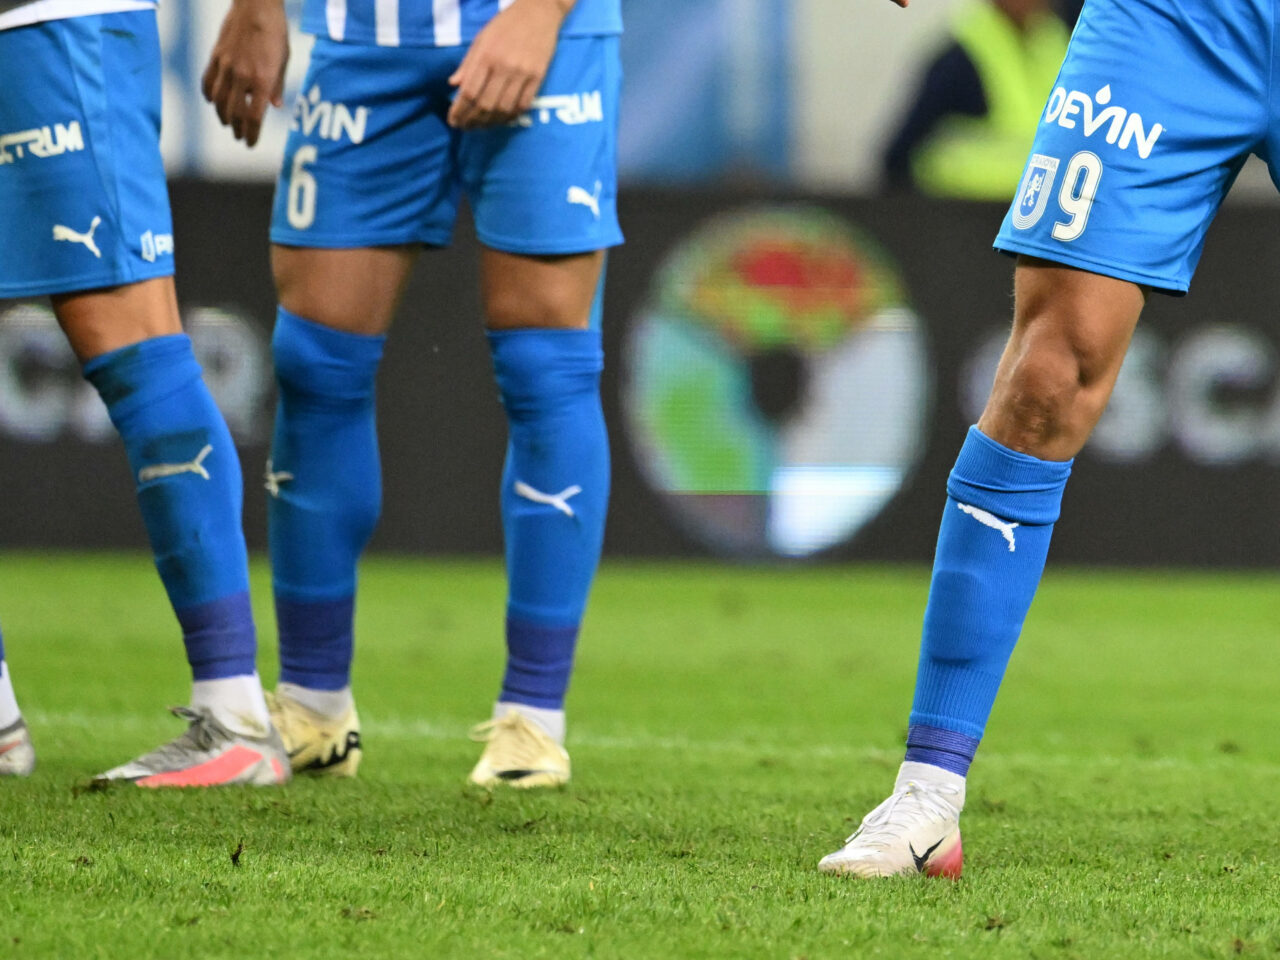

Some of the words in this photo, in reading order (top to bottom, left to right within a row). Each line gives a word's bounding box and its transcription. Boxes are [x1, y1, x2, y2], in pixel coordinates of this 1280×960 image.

[0, 120, 85, 166] CTRUM
[518, 90, 603, 128] TRUM
[1045, 83, 1165, 160] DEVIN
[288, 144, 318, 230] 6
[1051, 150, 1103, 242] 9
